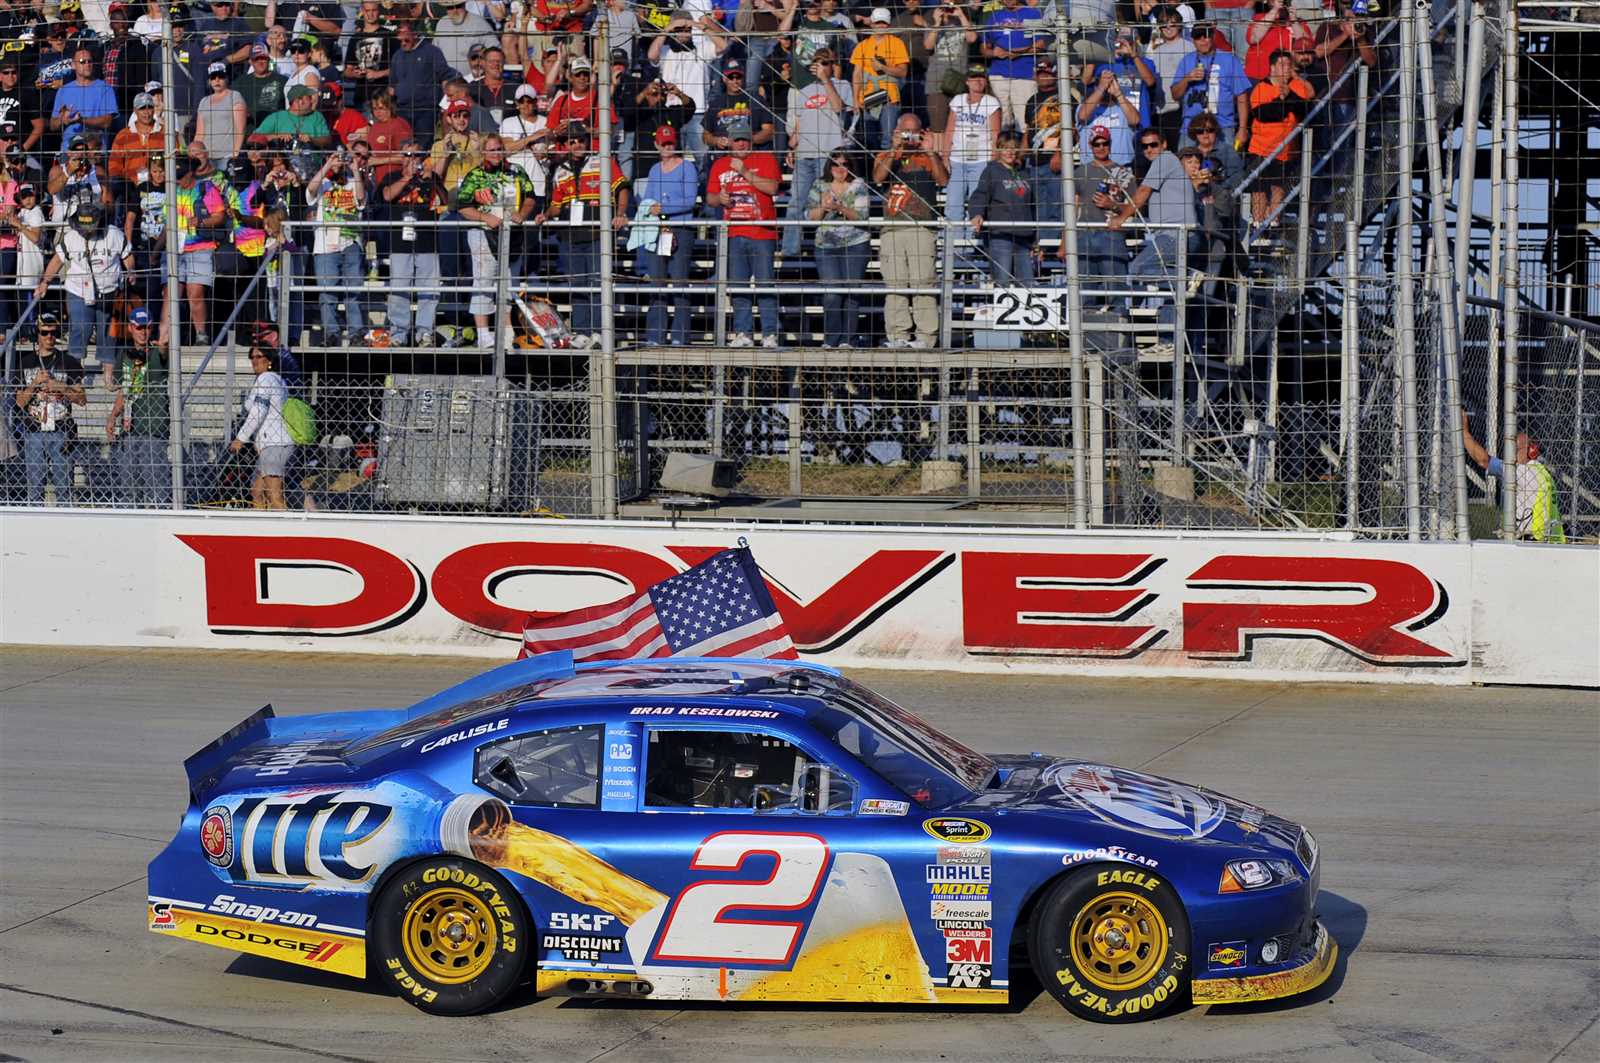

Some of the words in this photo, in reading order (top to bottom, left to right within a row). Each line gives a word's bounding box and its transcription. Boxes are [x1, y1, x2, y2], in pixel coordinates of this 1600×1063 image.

[996, 293, 1067, 325] 251
[174, 534, 1467, 666] DOVER
[630, 707, 674, 715] BRAD
[678, 707, 780, 719] KESELOWSKI
[420, 718, 509, 753] CARLISLE
[611, 744, 632, 759] PPG
[1062, 845, 1158, 868] GOODYEAR
[928, 865, 990, 879] MAHLE
[1097, 870, 1160, 891] EAGLE
[652, 830, 830, 965] 2
[931, 883, 989, 895] MOOG
[208, 894, 318, 926] Snap-on
[422, 867, 516, 953] GOODYEAR
[945, 909, 989, 918] freescale
[549, 912, 615, 931] SKF
[939, 921, 982, 930] LINCOLN
[195, 923, 323, 953] DODGE
[543, 936, 621, 951] DISCOUNT
[563, 950, 599, 960] TIRE
[948, 939, 991, 963] 3M
[1212, 951, 1244, 961] SUNOCO
[386, 957, 440, 1003] EAGLE
[1056, 966, 1178, 1016] GOODYEAR
